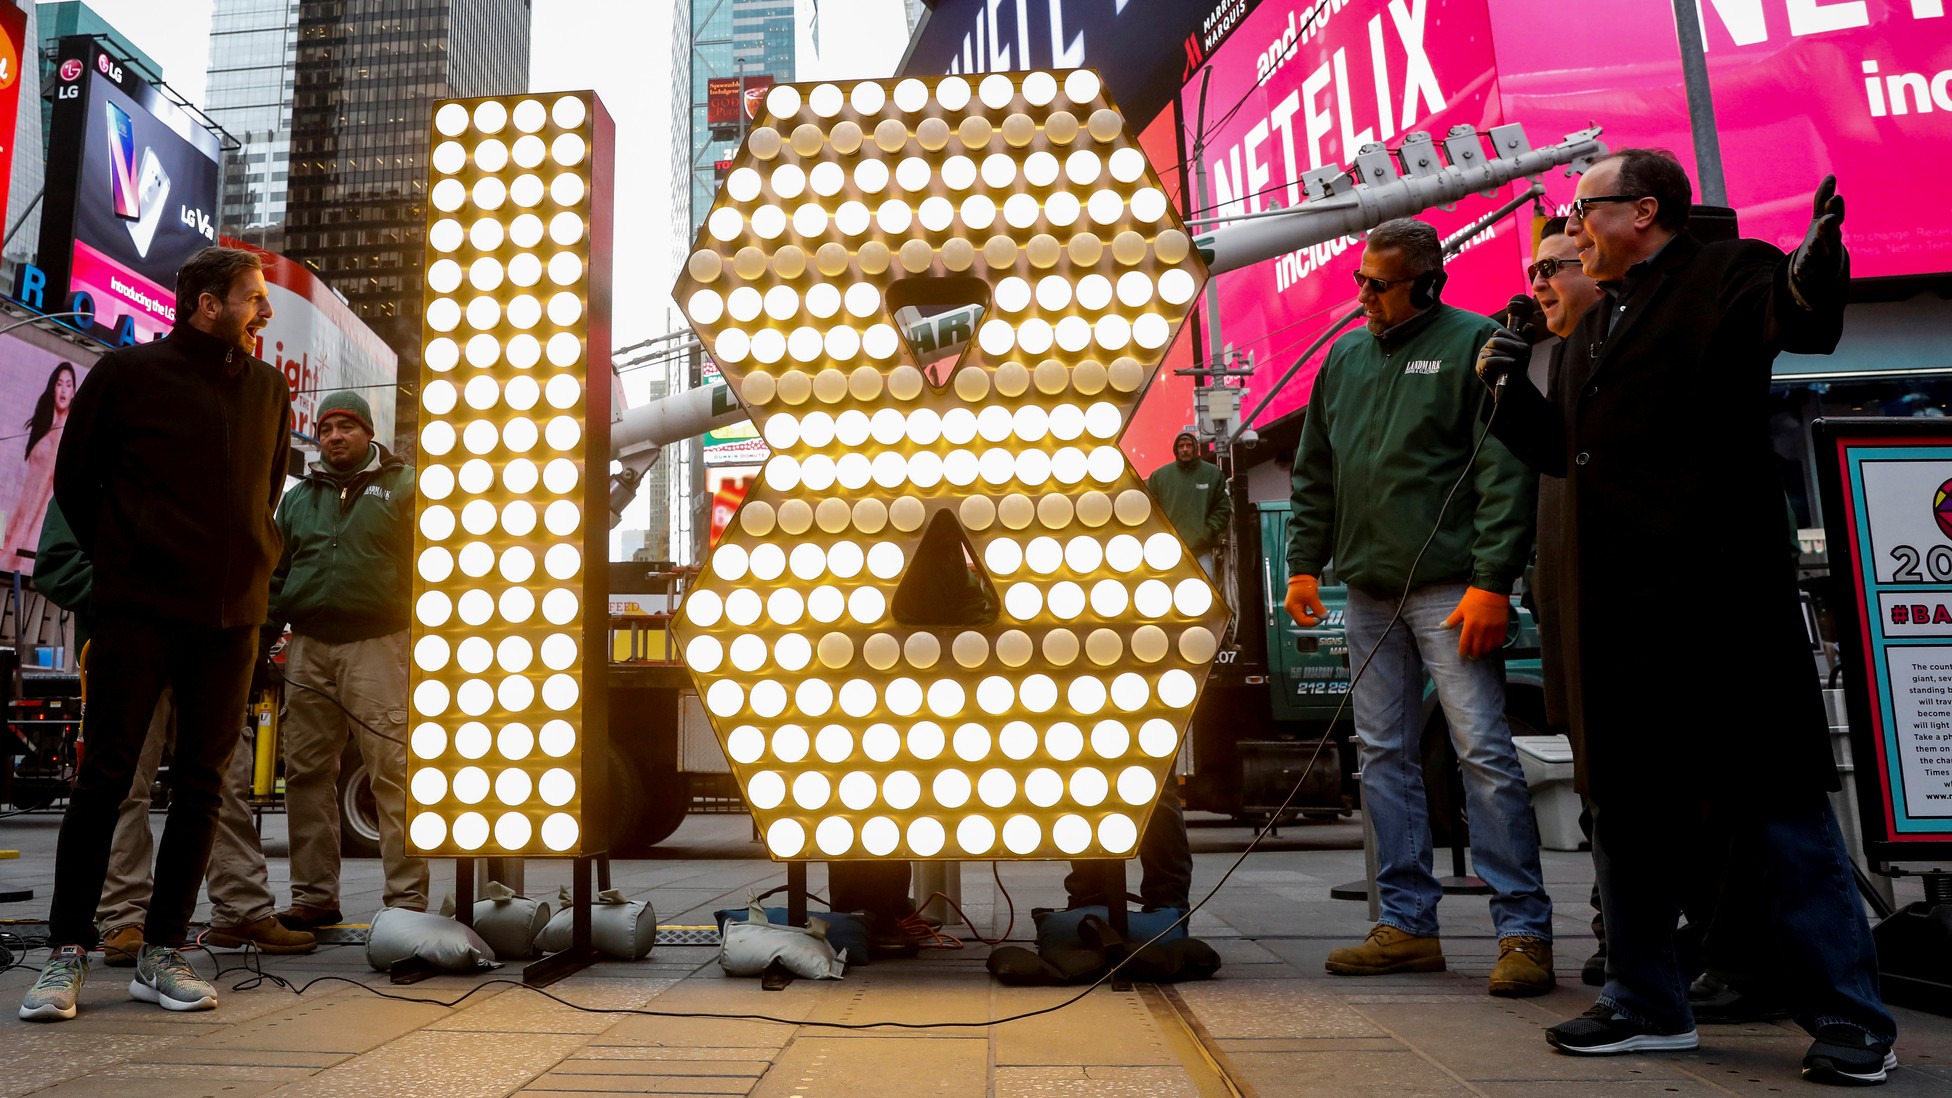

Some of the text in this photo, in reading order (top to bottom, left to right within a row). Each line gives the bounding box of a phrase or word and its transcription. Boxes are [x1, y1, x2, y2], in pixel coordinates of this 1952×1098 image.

[1205, 0, 1246, 51] MARQUIS
[1257, 10, 1298, 87] and
[109, 62, 123, 83] LG
[58, 85, 79, 99] LG
[1213, 0, 1447, 228] NETFLIX
[181, 205, 195, 227] LG
[1274, 227, 1376, 293] includ
[111, 276, 175, 321] Introducing the LG
[1405, 360, 1442, 371] LANDMARK
[1319, 637, 1344, 646] SIGNS
[1214, 651, 1237, 664] 07
[1912, 675, 1936, 683] giant,
[1913, 721, 1950, 730] will light
[1914, 733, 1933, 741] Take
